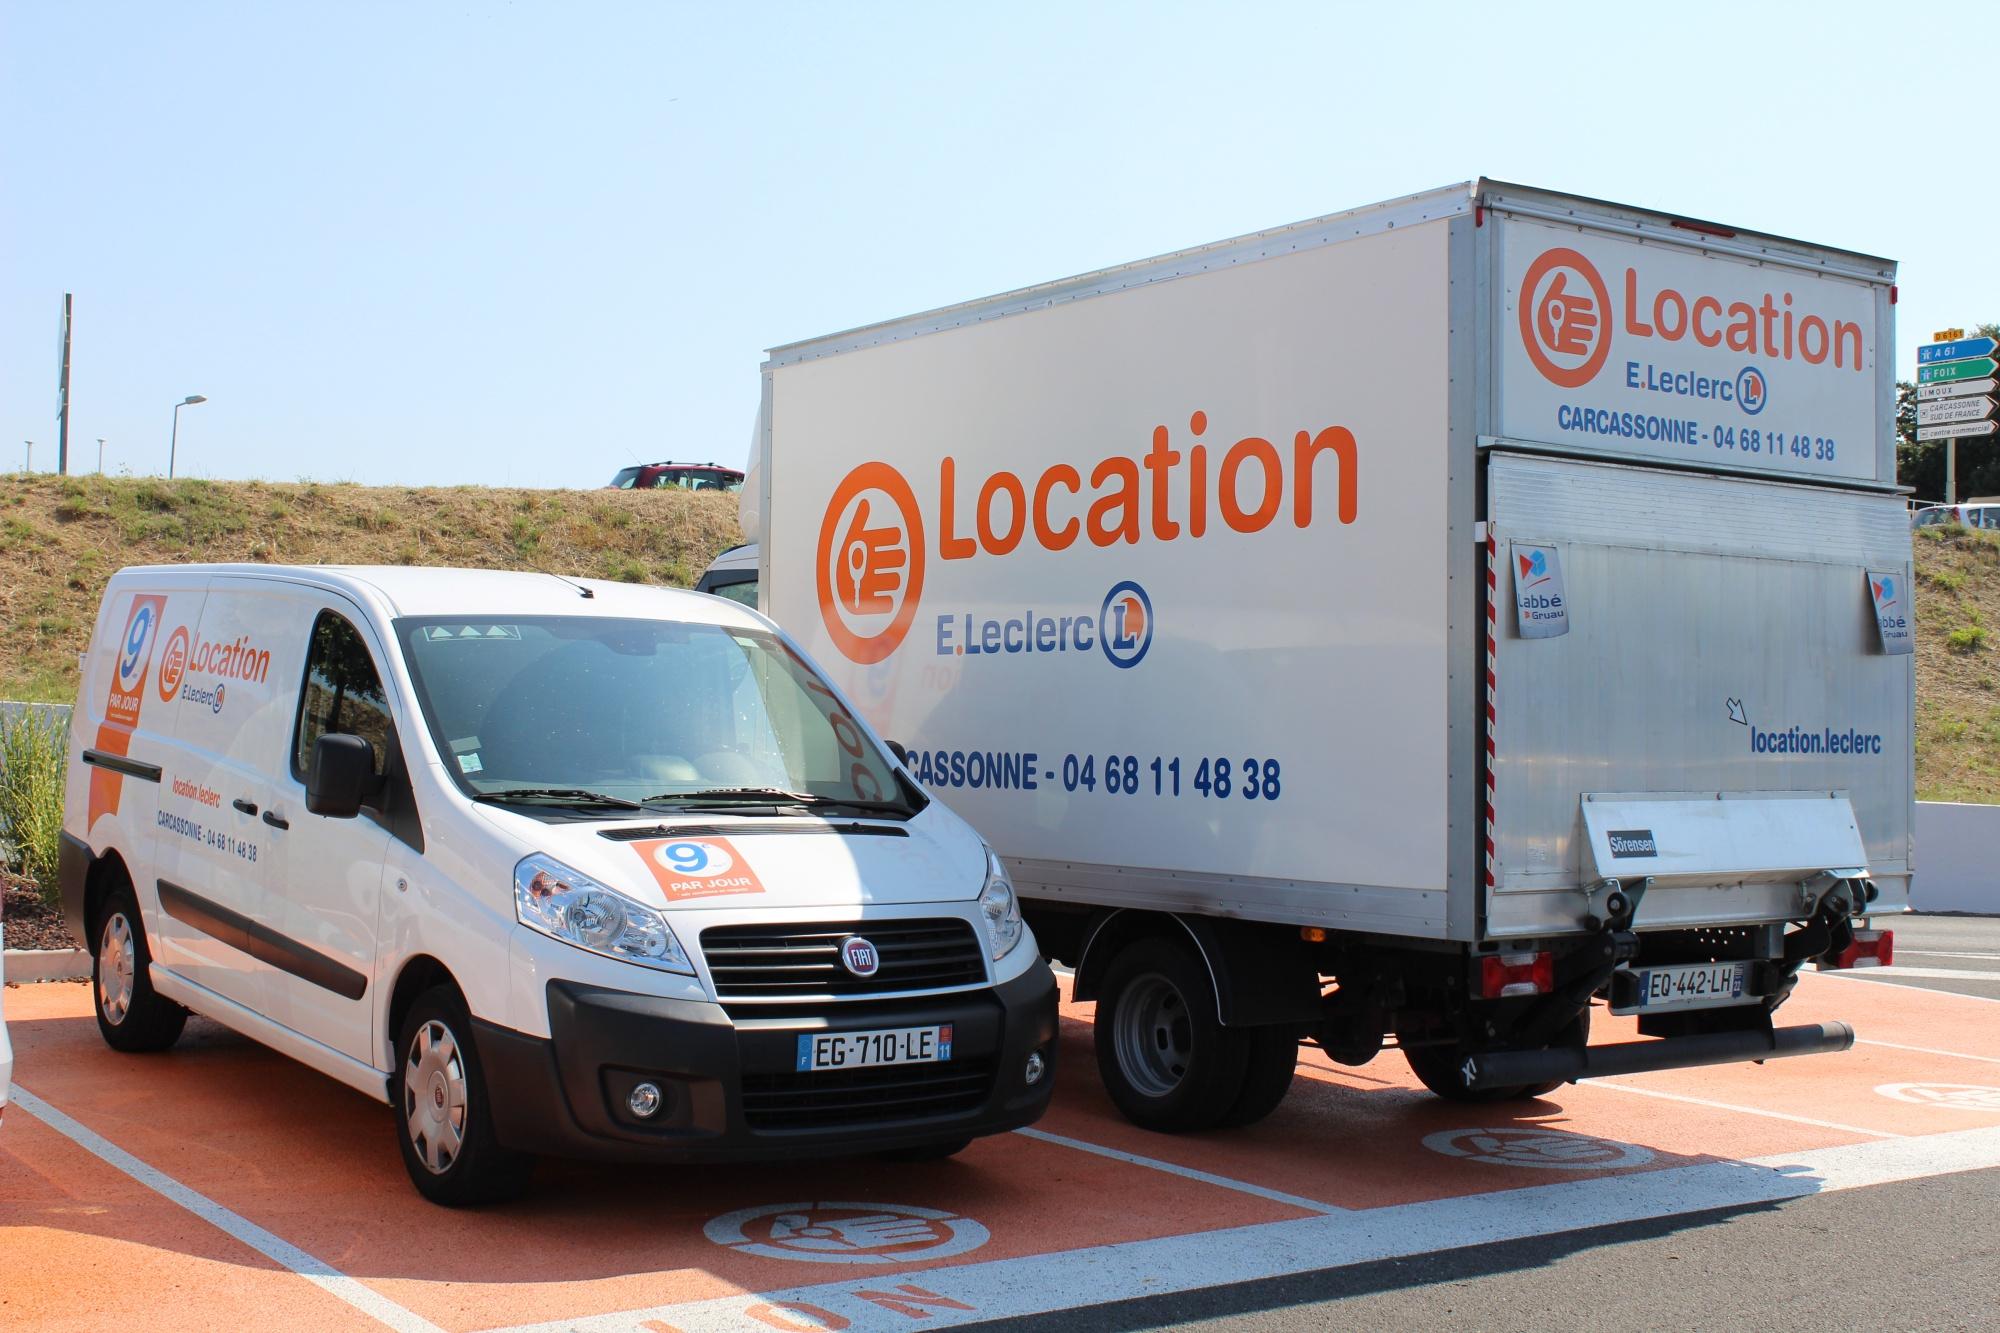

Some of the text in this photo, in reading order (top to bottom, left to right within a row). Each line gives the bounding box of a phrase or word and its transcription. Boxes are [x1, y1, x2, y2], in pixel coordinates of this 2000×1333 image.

[1625, 267, 1862, 372] Location
[1935, 347, 1956, 357] A 61
[1626, 361, 1733, 402] E.Leclerc
[1934, 368, 1956, 378] FOIX
[1920, 387, 1952, 397] LIMOUX
[1930, 399, 1980, 412] CARCASSONNE
[1930, 409, 1980, 421] SUD DE FRANCE
[1558, 405, 1697, 445] CARCASSONNE
[1713, 426, 1734, 450] 04
[1740, 429, 1760, 453] 68
[1766, 432, 1783, 456] 11
[1791, 434, 1810, 459] 48
[1815, 437, 1834, 461] 38
[1930, 424, 1990, 437] centre commercial
[940, 410, 1358, 560] Location
[1532, 610, 1564, 620] Gruau
[121, 607, 150, 678] 9
[937, 610, 1094, 655] E.Leclerc
[189, 632, 270, 684] Location
[110, 693, 138, 712] PAR JOUR
[182, 684, 213, 706] E.Leclerc
[1751, 725, 1881, 755] location.leclerc
[1063, 754, 1097, 794] 04
[1105, 755, 1139, 795] 68
[1150, 757, 1181, 796] 11
[1194, 757, 1232, 798] 48
[1242, 758, 1281, 800] 38
[173, 776, 221, 808] location.leclerc
[158, 810, 202, 841] CARCASSONNE
[207, 829, 215, 847] 04
[217, 833, 226, 850] 68
[228, 837, 235, 854] 11
[237, 841, 246, 858] 48
[248, 844, 257, 862] 38
[1610, 837, 1655, 852] Sörensen
[666, 843, 708, 872] 9
[671, 877, 752, 892] PAR JOUR
[851, 949, 872, 966] FIAT
[1651, 968, 1732, 998] EQ-442-LH
[816, 1031, 932, 1066] EG-710-LE
[940, 1045, 950, 1058] 11
